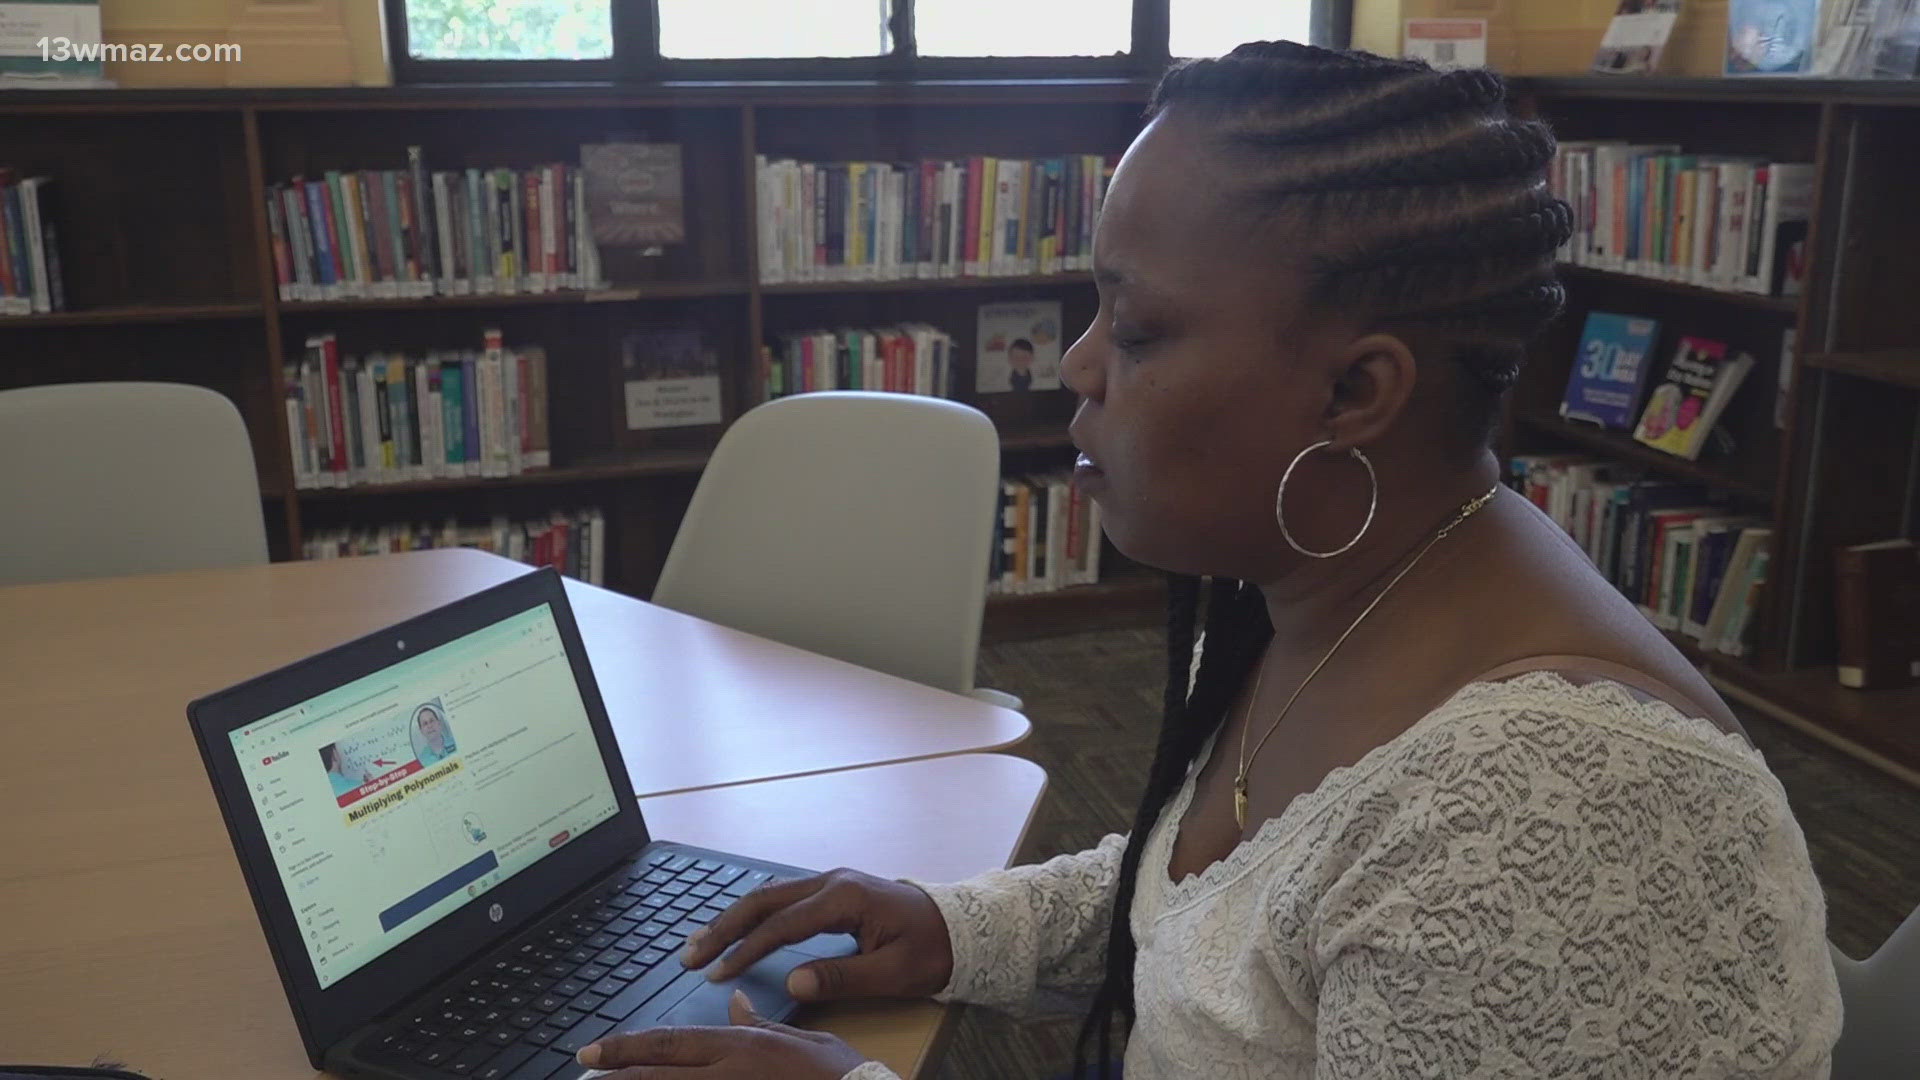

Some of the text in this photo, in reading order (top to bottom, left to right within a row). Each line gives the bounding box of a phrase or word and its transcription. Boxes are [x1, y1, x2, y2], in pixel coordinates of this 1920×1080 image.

[348, 790, 404, 823] Multiplying
[403, 761, 460, 795] Polynomials
[359, 768, 408, 796] Step-by-Step
